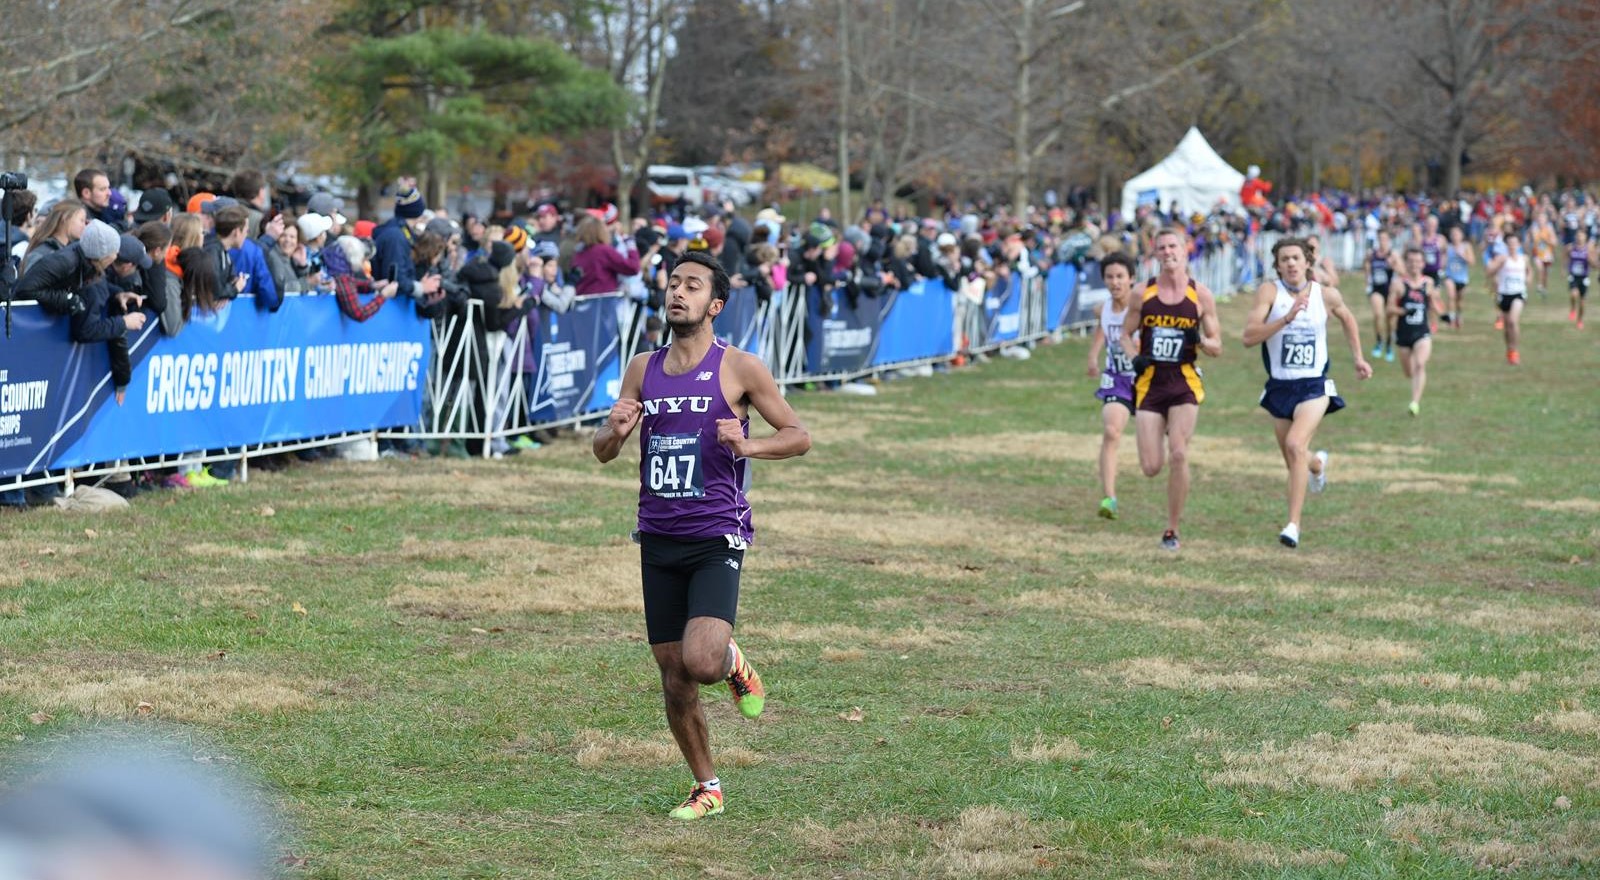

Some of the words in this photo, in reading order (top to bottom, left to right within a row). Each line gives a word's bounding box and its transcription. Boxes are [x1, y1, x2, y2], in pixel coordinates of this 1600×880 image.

[1143, 314, 1197, 329] CALVIN
[1152, 337, 1183, 359] 507
[1284, 343, 1315, 366] 739
[147, 353, 218, 414] CROSS
[219, 347, 301, 408] COUNTRY
[304, 342, 424, 400] CHAMPIONSHIPS
[1, 379, 49, 414] COUNTRY
[643, 396, 713, 417] NYU
[650, 455, 696, 490] 647
